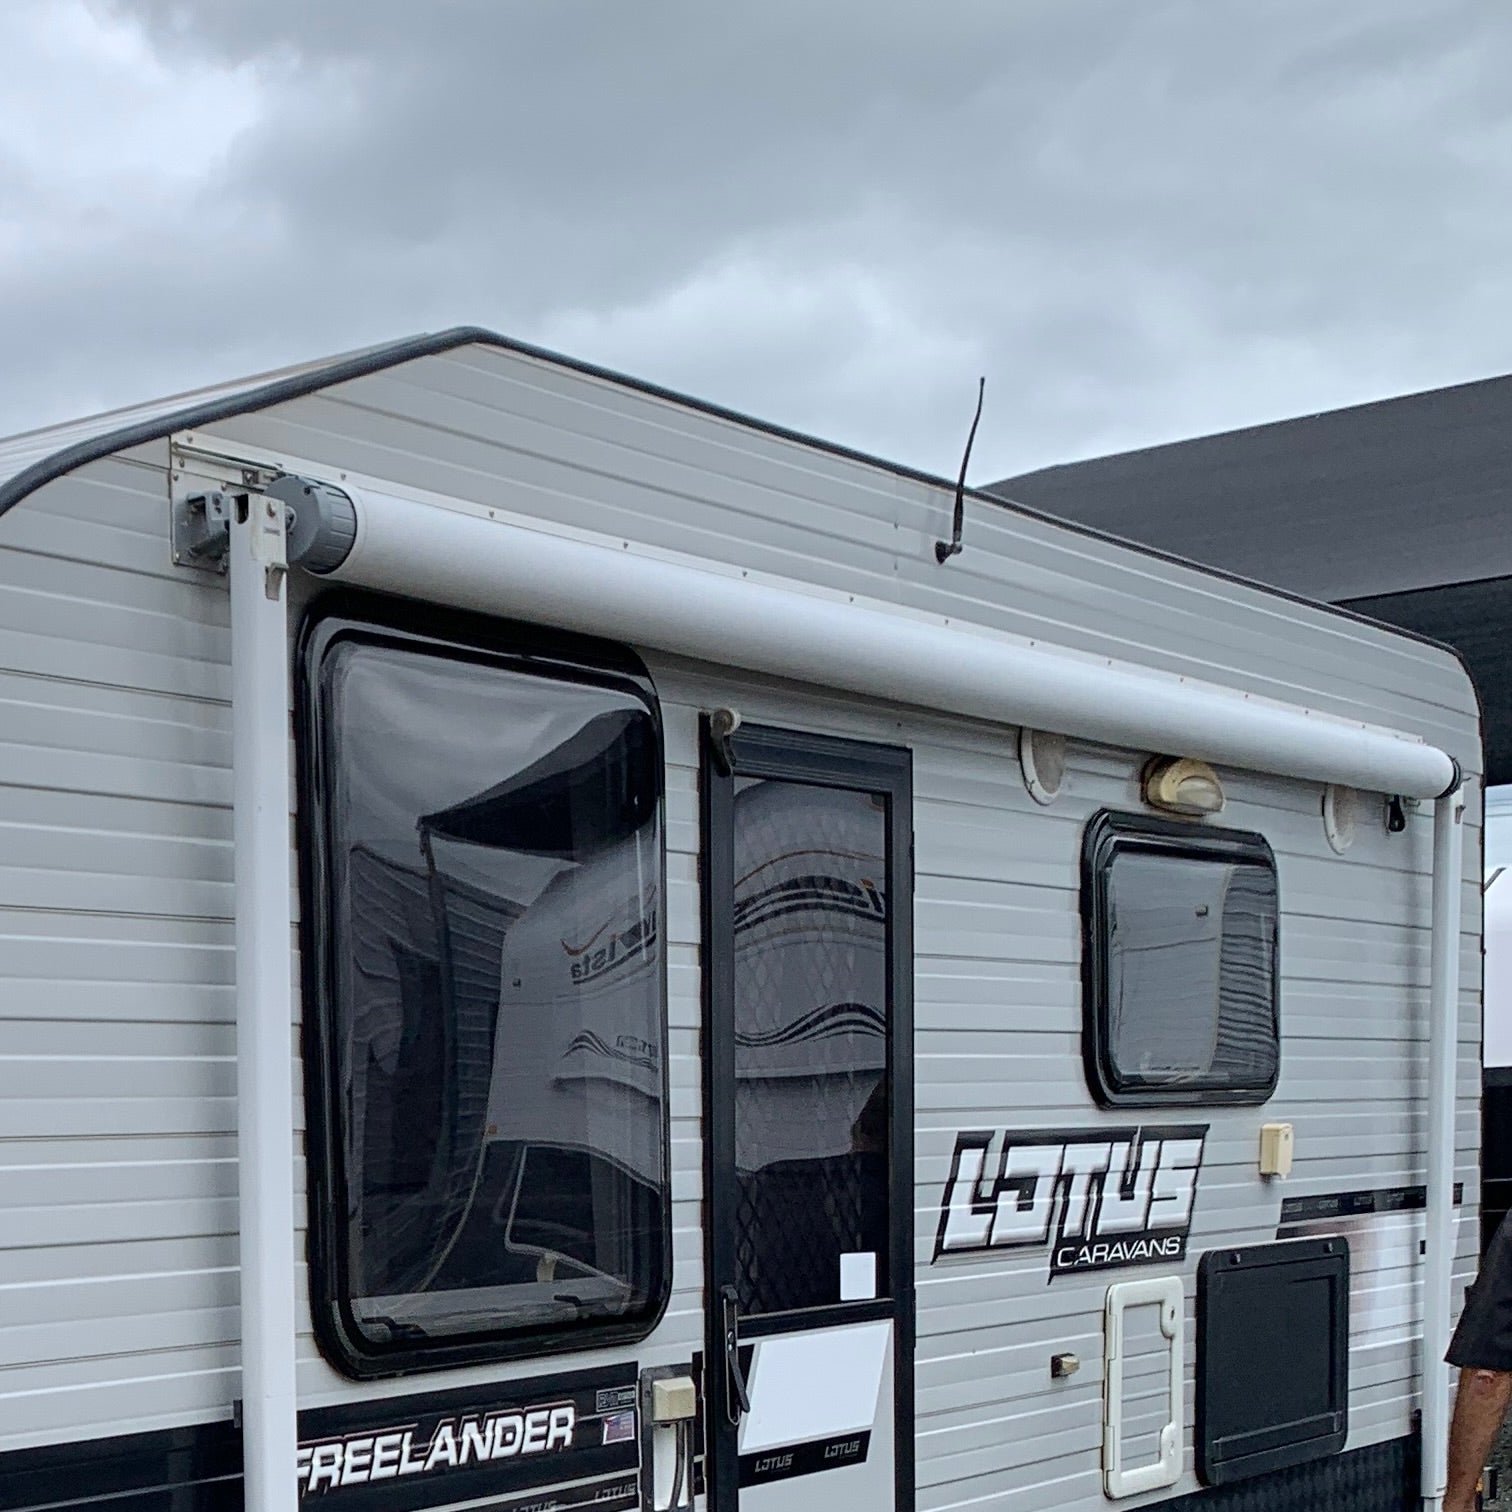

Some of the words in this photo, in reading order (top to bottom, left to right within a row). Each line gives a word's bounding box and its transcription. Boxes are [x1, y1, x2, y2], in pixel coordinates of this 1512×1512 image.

[938, 1132, 1206, 1252] LOTUS
[1058, 1235, 1181, 1267] CARAVANS
[754, 1453, 794, 1473] LOTUS
[824, 1440, 860, 1459] LOTUS
[594, 1482, 637, 1502] LOTUS
